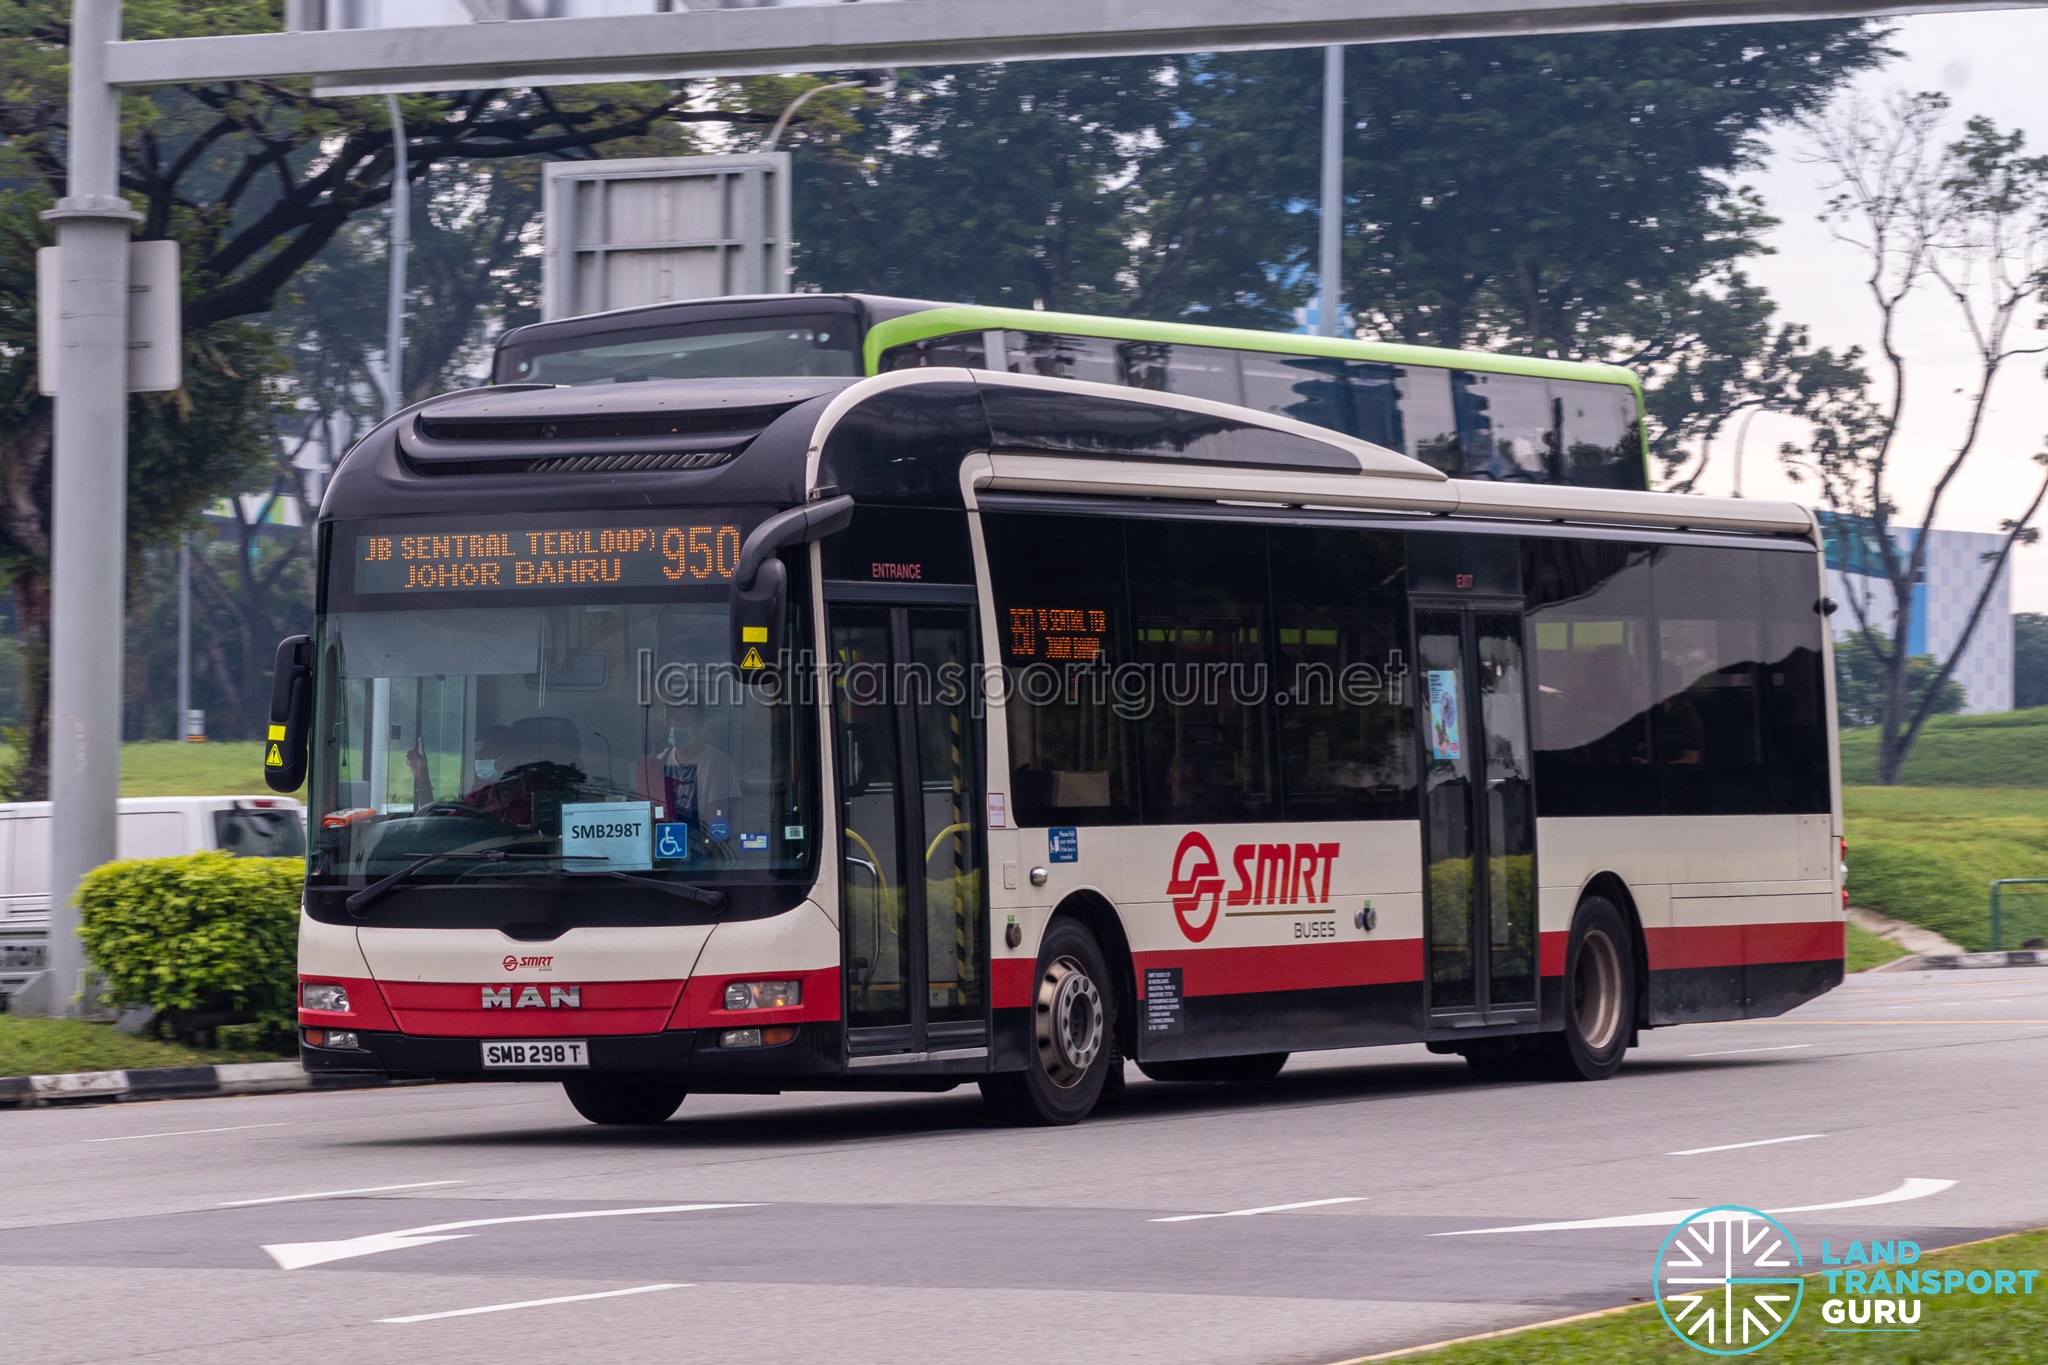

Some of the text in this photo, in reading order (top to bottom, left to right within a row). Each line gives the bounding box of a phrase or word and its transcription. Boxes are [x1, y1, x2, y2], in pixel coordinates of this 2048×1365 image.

[365, 537, 393, 562] JB
[401, 533, 516, 561] SENTRAL
[662, 525, 740, 580] 950
[404, 558, 621, 589] JOHOR BAHRU
[872, 562, 922, 579] ENTRANCE
[571, 823, 642, 839] SMB298T
[1227, 842, 1340, 907] SMRT
[1294, 921, 1336, 939] BUSES
[519, 956, 554, 966] SMRT
[482, 986, 580, 1008] MAN
